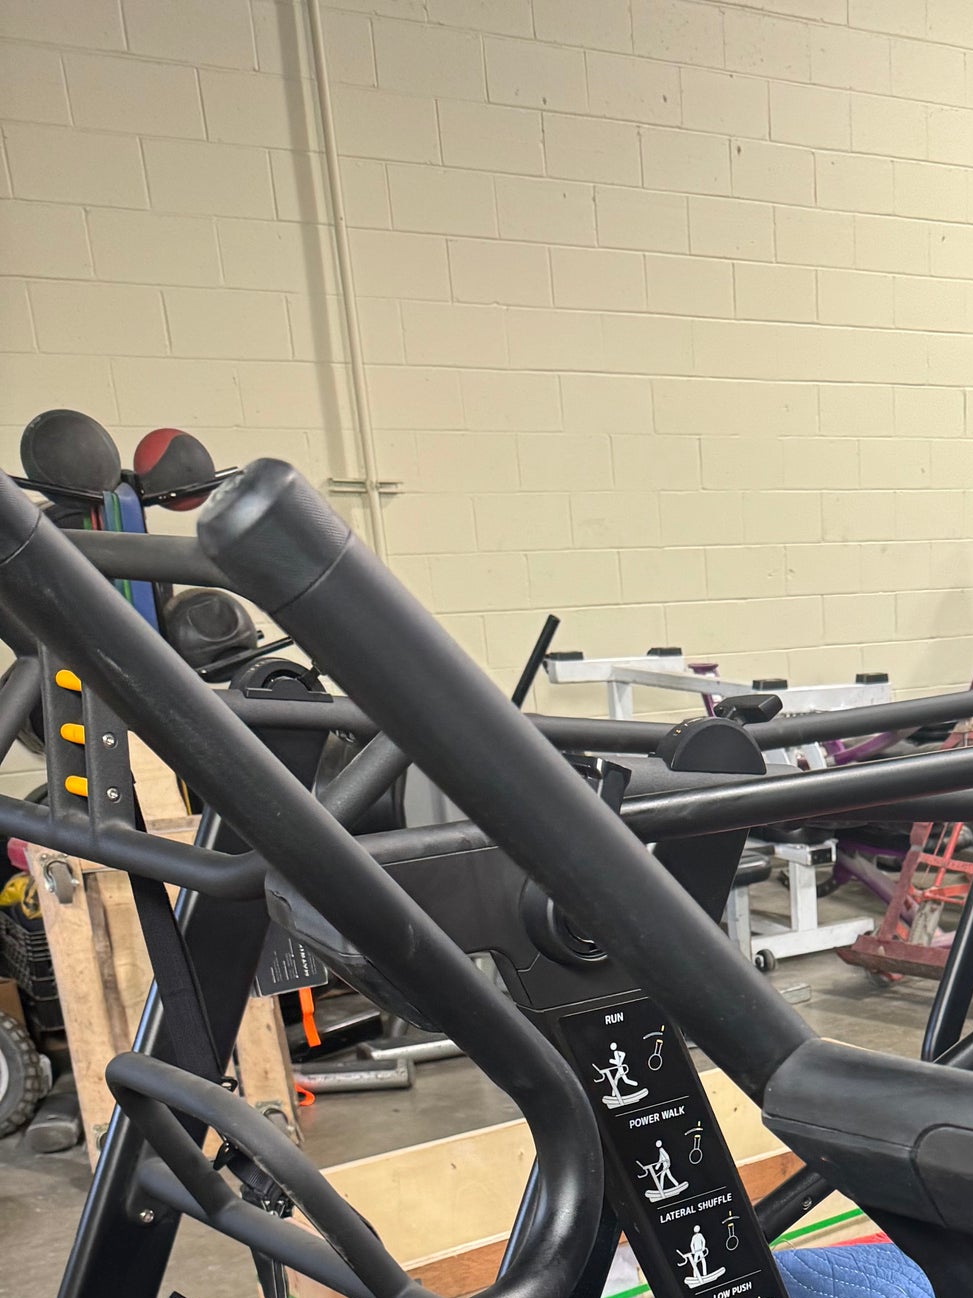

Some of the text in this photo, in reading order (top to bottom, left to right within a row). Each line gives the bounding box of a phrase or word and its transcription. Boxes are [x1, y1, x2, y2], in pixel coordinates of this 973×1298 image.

[604, 1012, 624, 1025] RUN
[629, 1105, 685, 1129] POWER WALK
[660, 1193, 733, 1223] LATERAL SHUFFLE
[732, 1281, 752, 1296] PUSH
